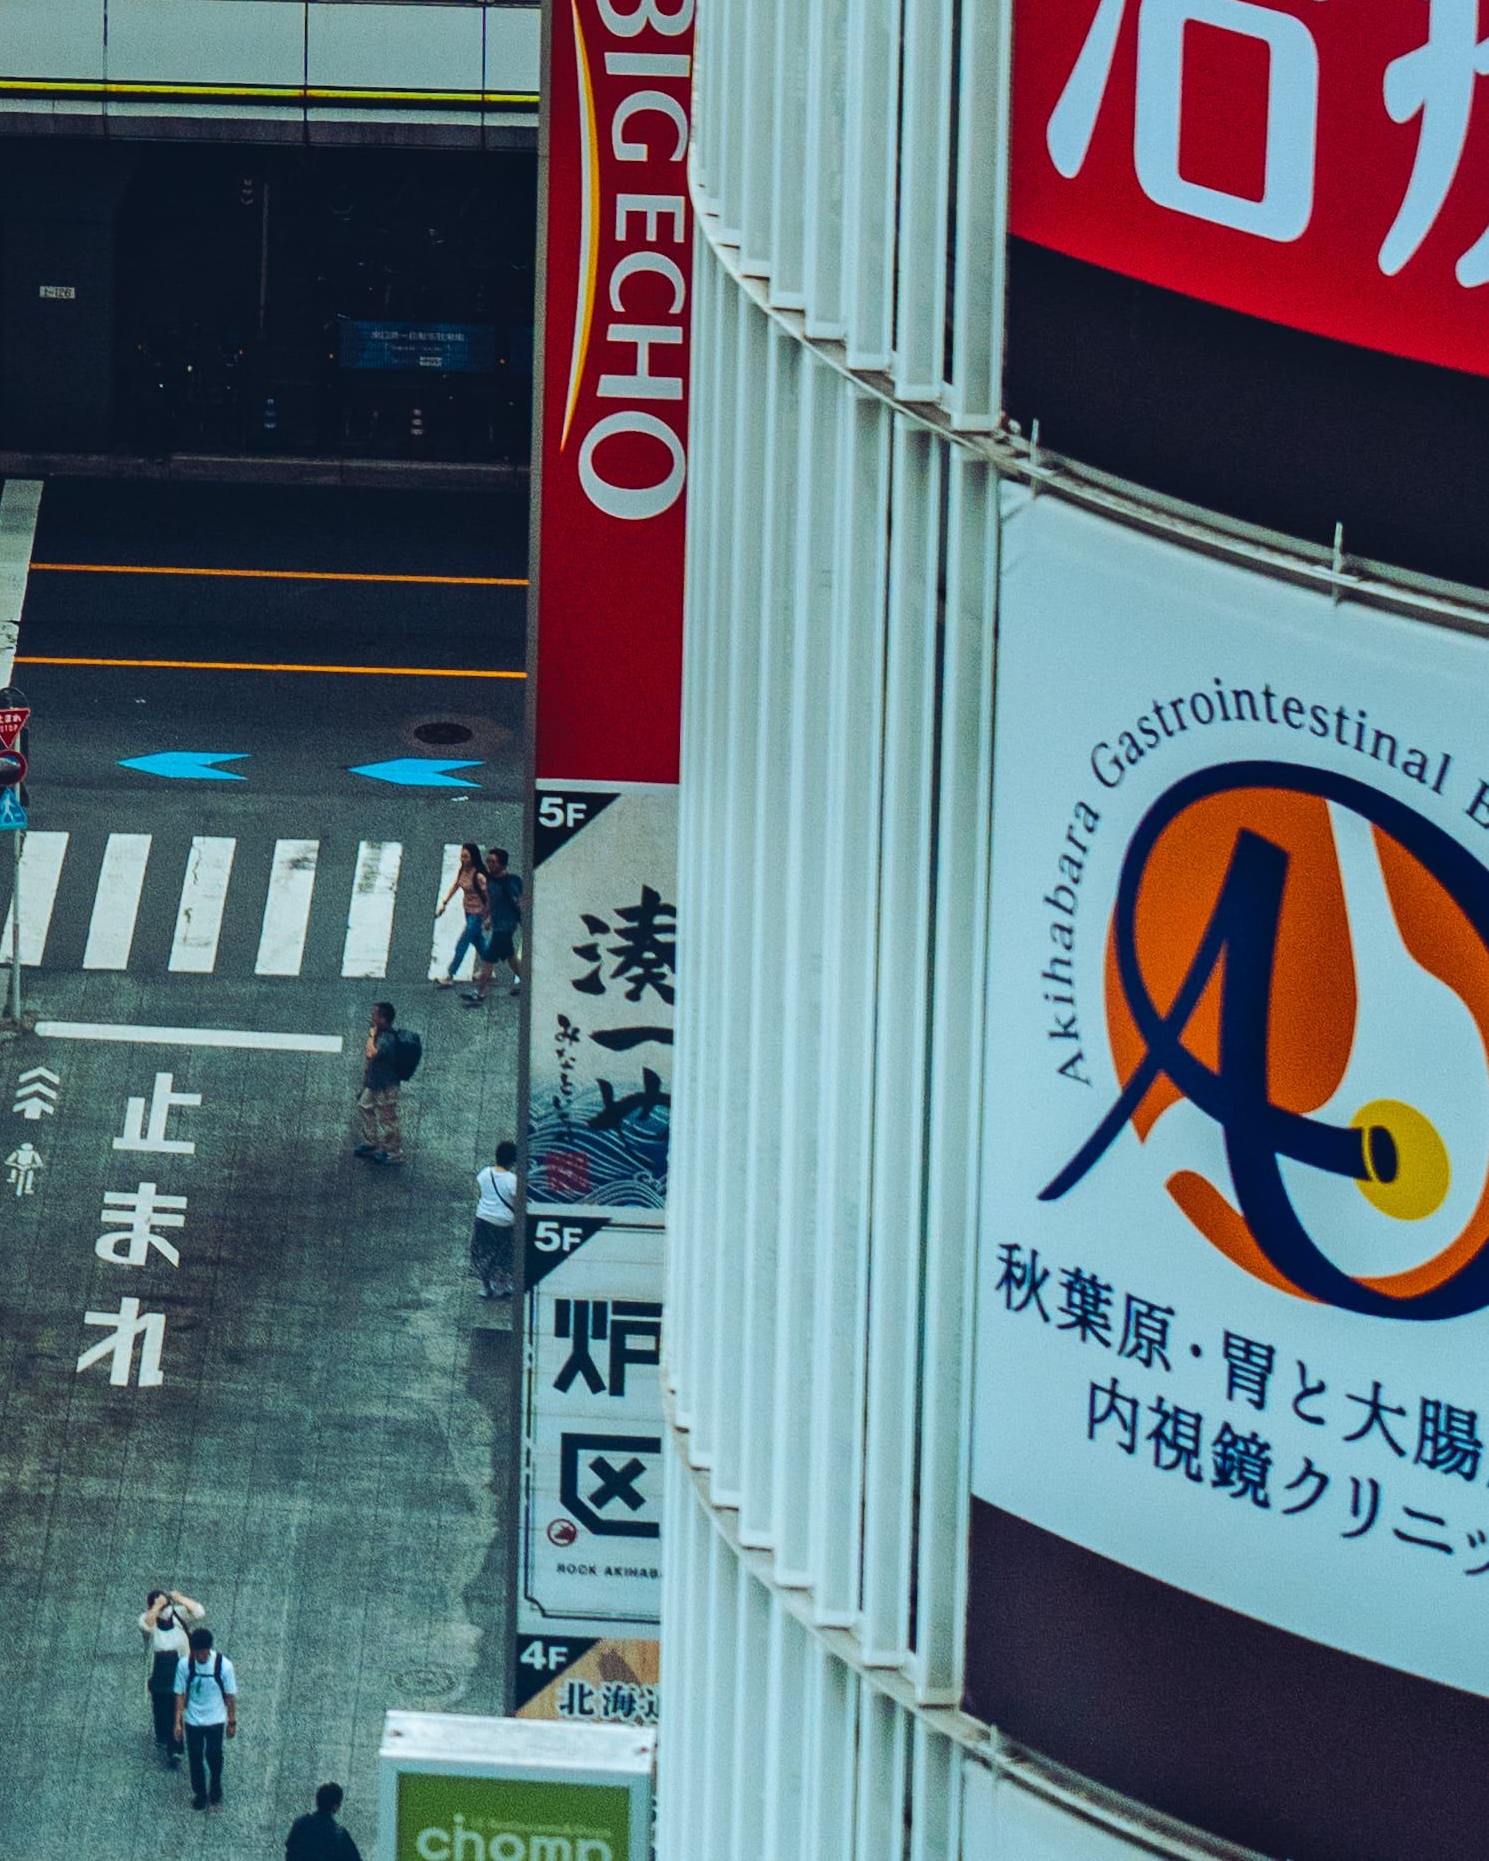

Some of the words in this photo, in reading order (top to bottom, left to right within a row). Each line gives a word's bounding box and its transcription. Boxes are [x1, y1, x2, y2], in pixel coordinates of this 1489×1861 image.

[577, 190, 688, 520] ECHO
[538, 796, 588, 829] 5F
[1041, 799, 1101, 1087] Akihabara
[1089, 676, 1453, 796] Gastrointestinal
[75, 1071, 203, 1388] 止まれ
[533, 1221, 583, 1253] 5F
[994, 1241, 1485, 1482] 秋葉原・胃と大腸
[604, 1564, 664, 1579] AKIHAB
[520, 1641, 569, 1671] 4F
